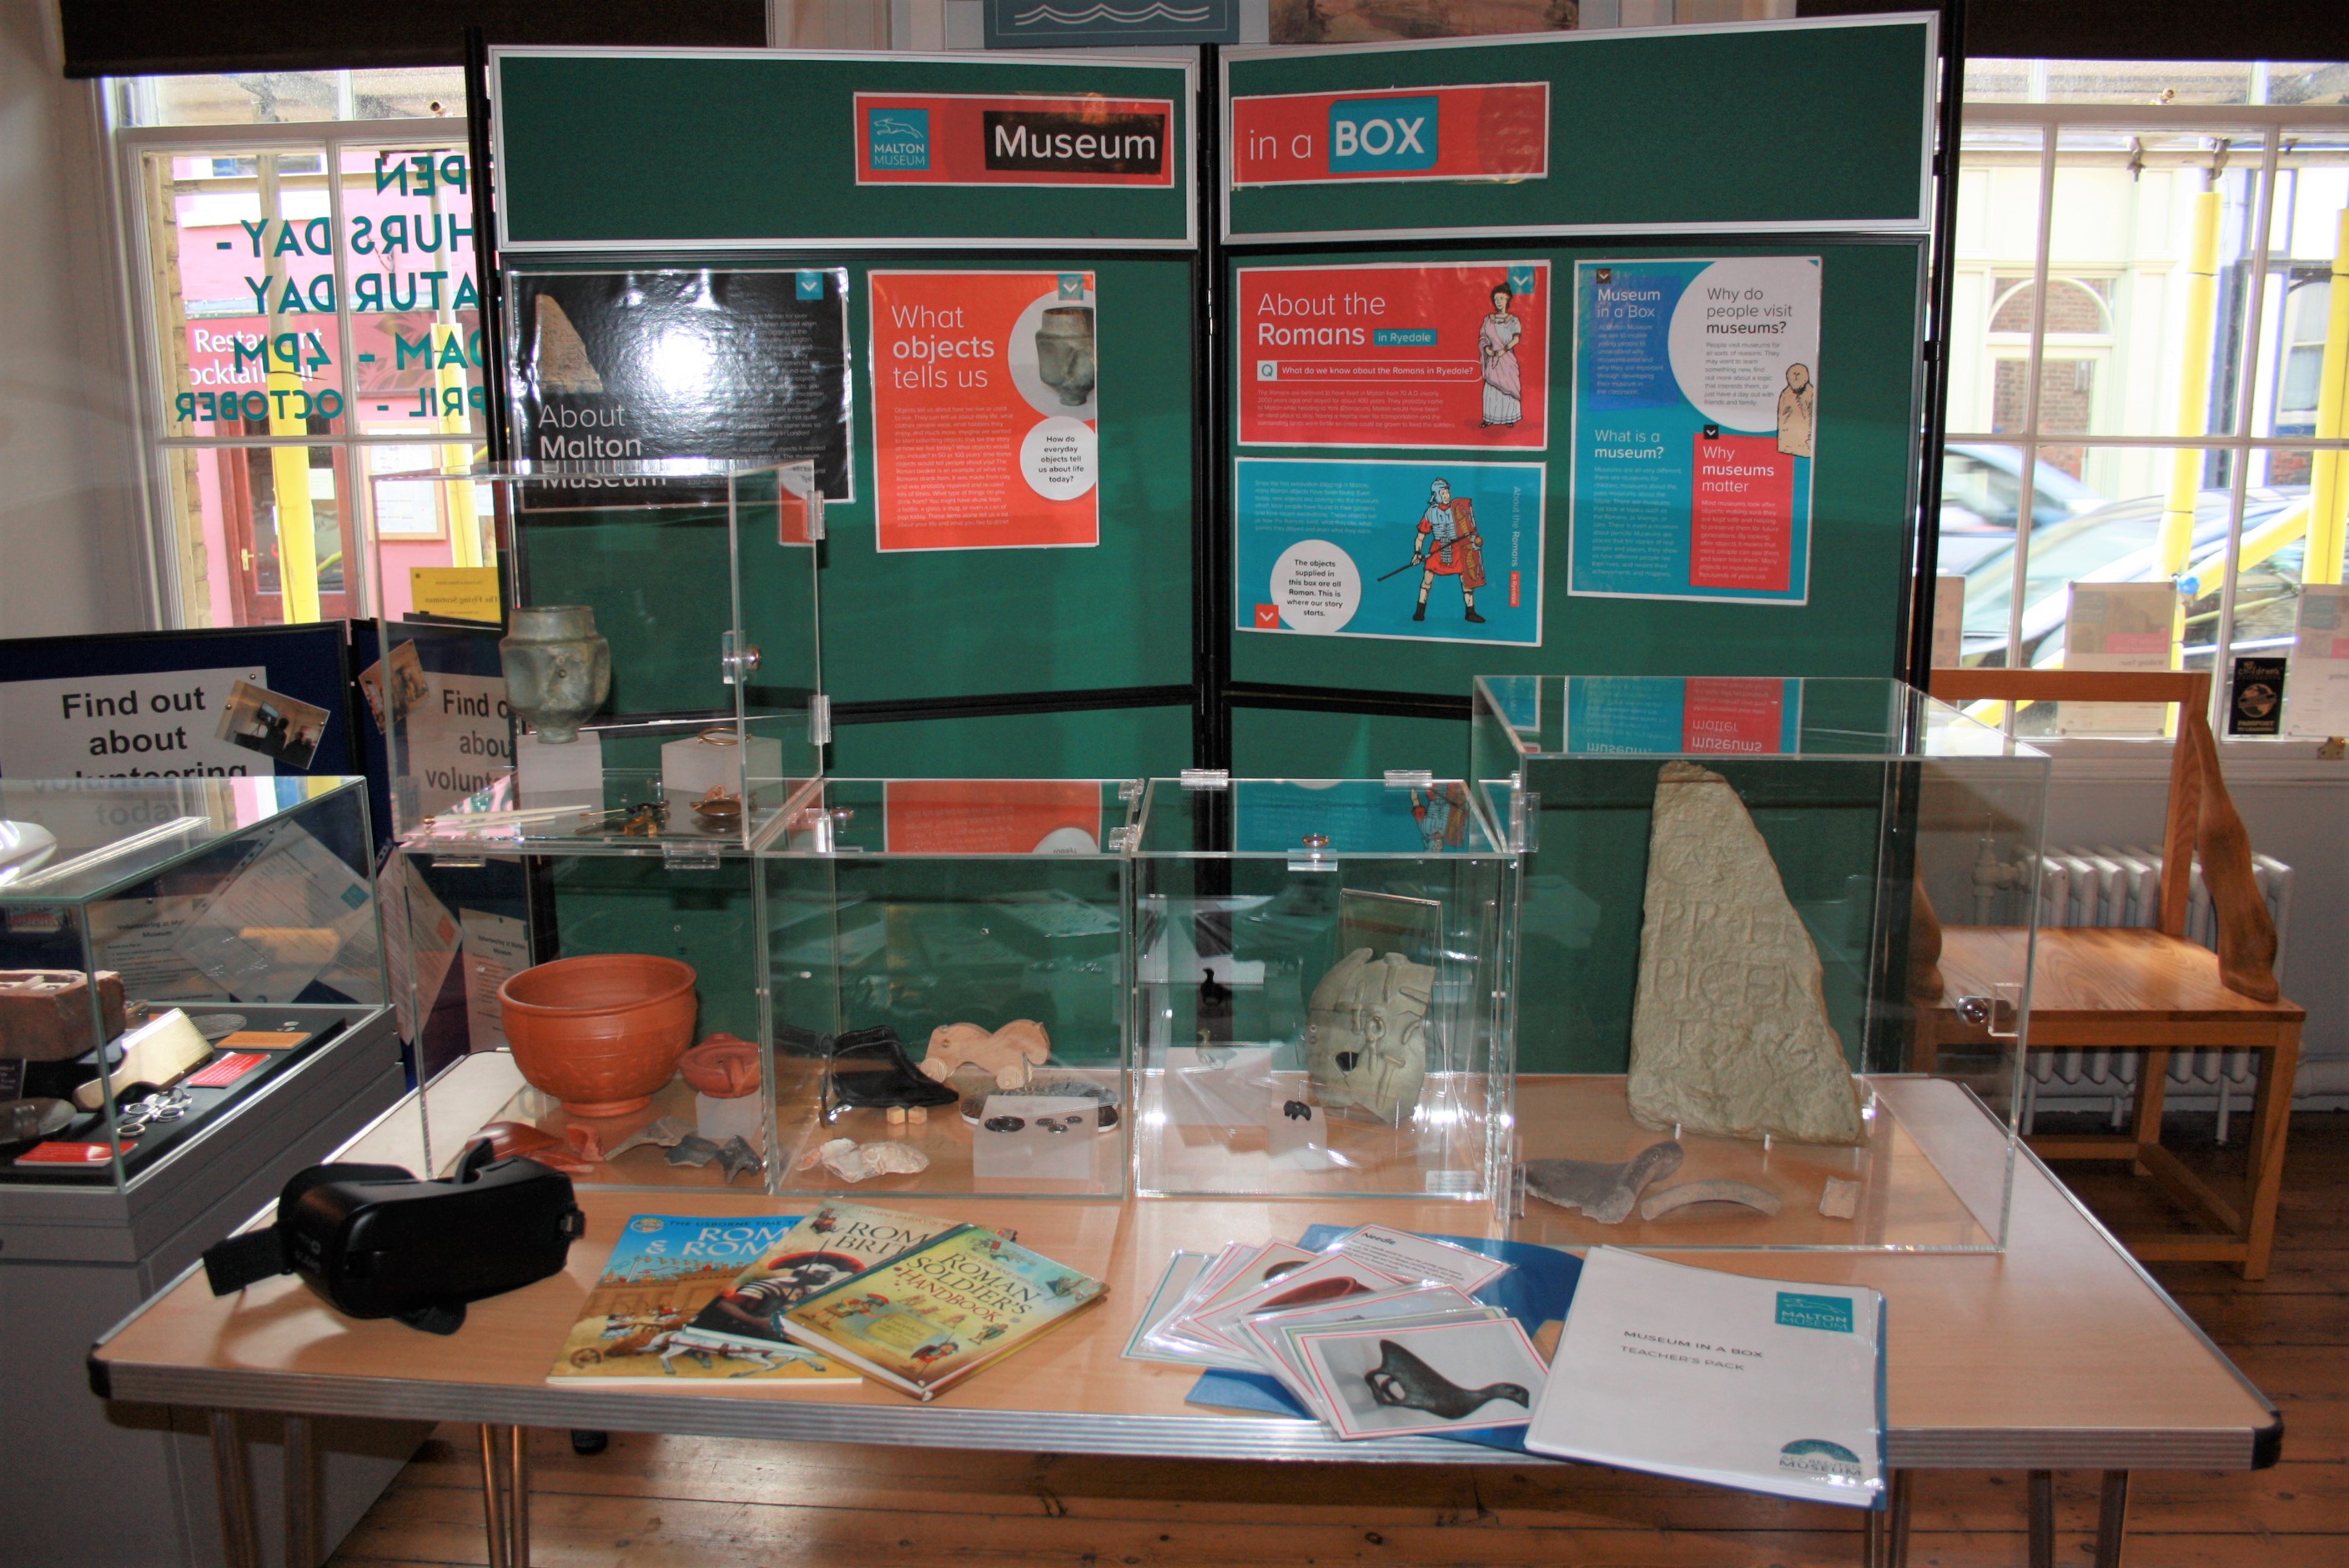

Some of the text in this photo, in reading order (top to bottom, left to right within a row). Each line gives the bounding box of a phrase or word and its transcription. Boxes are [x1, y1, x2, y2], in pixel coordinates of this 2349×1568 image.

[995, 125, 1154, 160] Museum
[1249, 117, 1425, 160] in a BOX
[874, 143, 924, 154] MALTON
[874, 155, 925, 166] MUSEUM
[1597, 289, 1661, 301] Museum
[1707, 287, 1763, 303] Why do
[1257, 292, 1386, 316] About the
[1707, 304, 1793, 320] people visit
[891, 305, 963, 328] What
[1597, 306, 1655, 319] in a Box
[1258, 323, 1365, 346] Romans
[1706, 320, 1787, 334] museums?
[194, 329, 322, 353] Restant
[1378, 333, 1431, 344] in Ryedale
[893, 334, 995, 364] objects
[189, 359, 266, 385] ocktail
[893, 365, 988, 389] tells us
[1261, 364, 1273, 377] Q
[1282, 366, 1302, 374] What
[1305, 366, 1314, 374] do
[1330, 366, 1351, 374] know
[1353, 366, 1375, 374] about
[1377, 366, 1391, 375] the
[1392, 367, 1425, 375] Romans
[1426, 367, 1435, 375] in
[1436, 366, 1473, 376] Ryedale?
[538, 404, 626, 429] About
[1594, 430, 1660, 443] What is a
[541, 434, 641, 460] Malton
[1044, 445, 1078, 454] everyday
[1594, 446, 1664, 459] museum?
[1703, 446, 1735, 462] Why
[1041, 455, 1068, 464] objects
[1702, 464, 1774, 476] museums
[1049, 475, 1074, 484] today?
[1702, 481, 1748, 492] matter
[1511, 531, 1521, 567] Romans
[1310, 560, 1335, 568] objects
[1295, 569, 1325, 577] supplied
[1304, 579, 1317, 587] box
[1289, 589, 1316, 597] Roman.
[1325, 600, 1343, 609] story
[62, 686, 206, 719] Find out
[442, 689, 489, 717] Find
[89, 726, 188, 756] about
[460, 731, 511, 759] abou
[698, 1227, 792, 1241] ROM
[848, 1222, 929, 1244] ROM
[1361, 1232, 1396, 1245] Needle
[907, 1256, 1033, 1314] SOLDIER'S
[940, 1253, 1042, 1302] ROMAN
[896, 1269, 1003, 1323] HANDBOOK
[1780, 1317, 1849, 1330] MUSEUM
[1781, 1310, 1848, 1323] MALTON
[1623, 1330, 1690, 1347] MUSEUM
[1696, 1342, 1710, 1350] IN
[1731, 1347, 1764, 1358] BOX
[1621, 1344, 1745, 1370] TEACHER'S PACK
